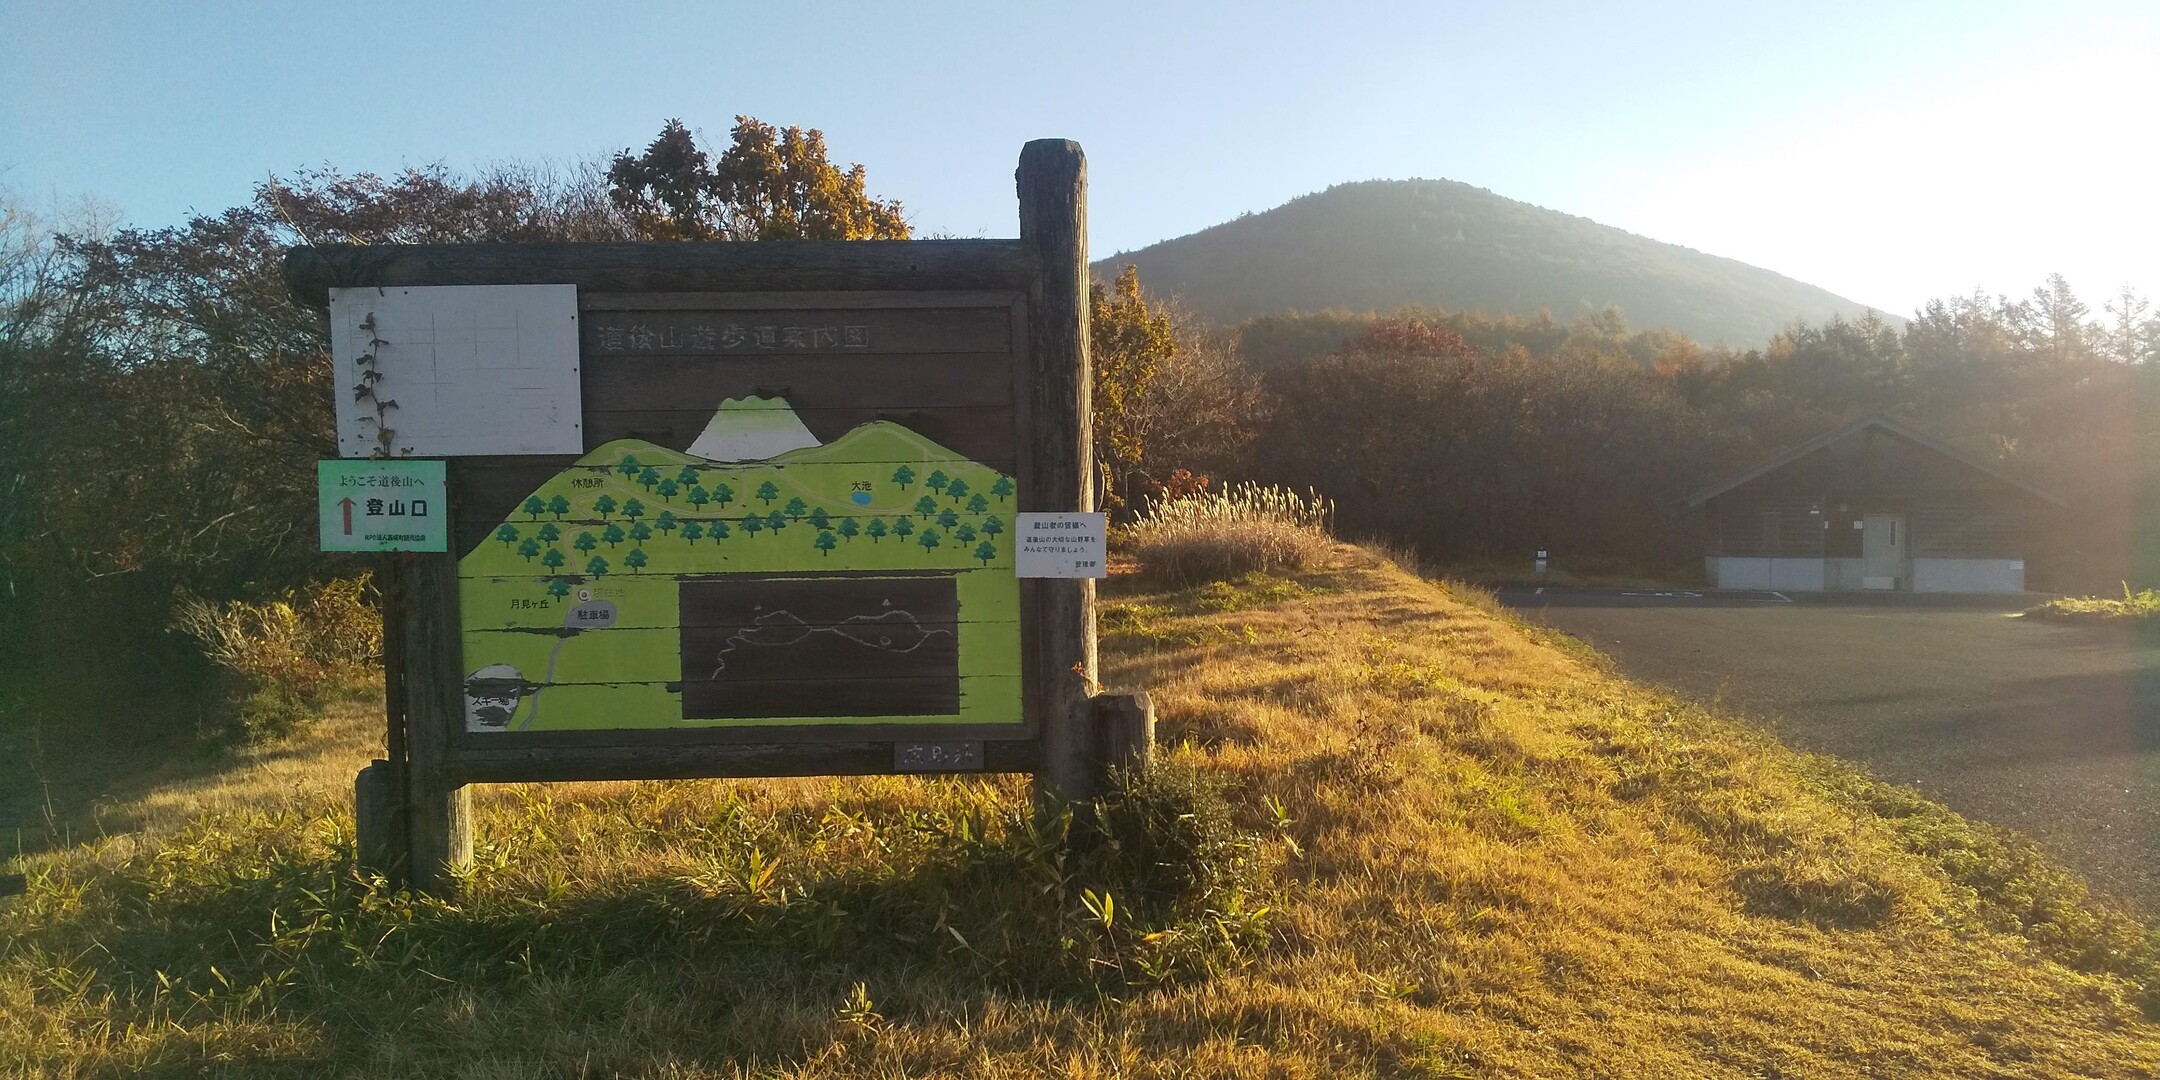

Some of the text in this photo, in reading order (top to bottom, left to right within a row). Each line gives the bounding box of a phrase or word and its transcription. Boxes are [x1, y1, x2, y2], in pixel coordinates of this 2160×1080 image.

[340, 475, 424, 487] ようこそ道後山へ
[571, 477, 604, 488] 休憩所
[851, 481, 872, 491] 大池
[366, 498, 427, 516] 登山口
[577, 610, 610, 620] 駐車場
